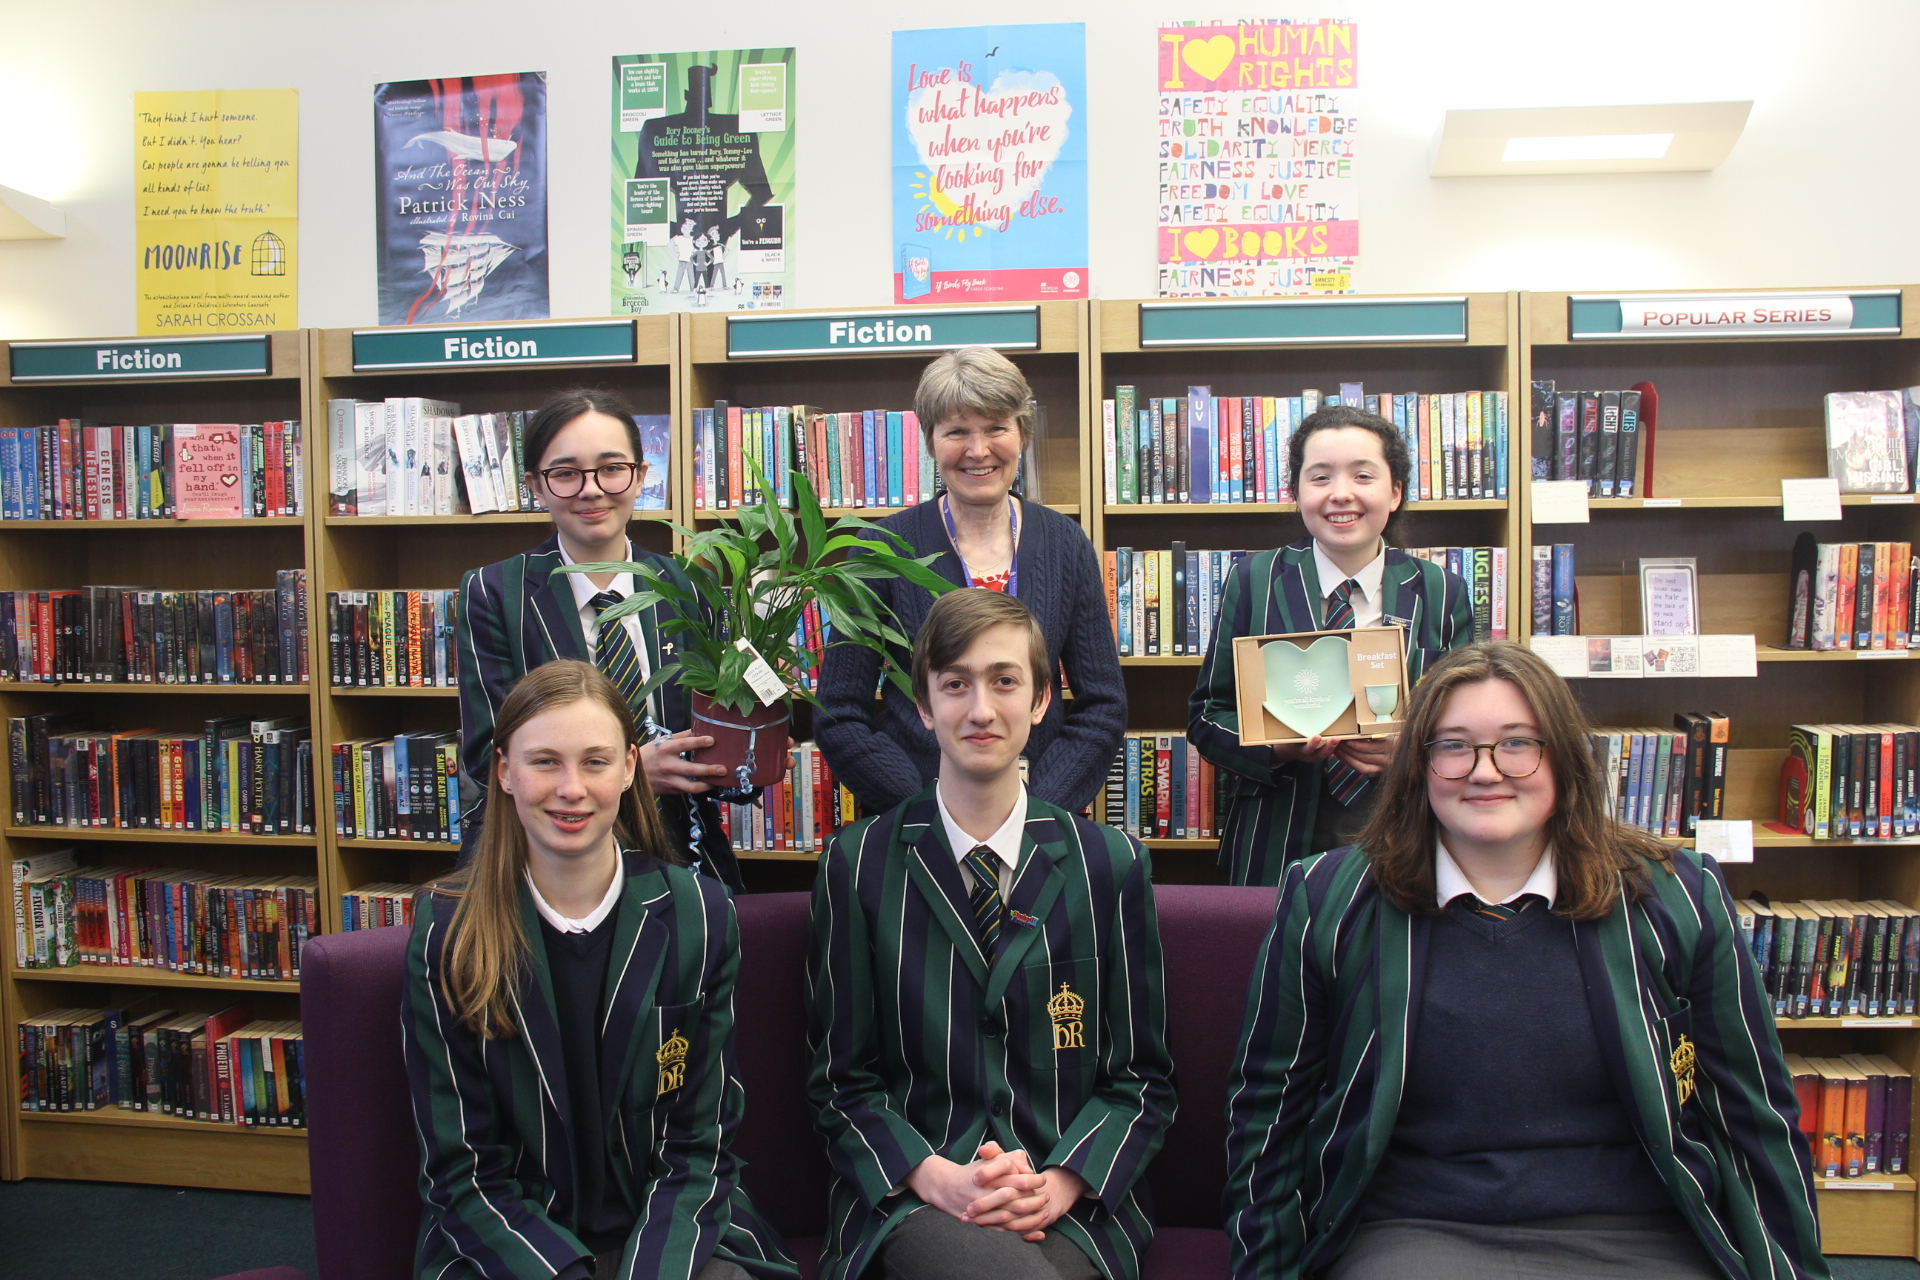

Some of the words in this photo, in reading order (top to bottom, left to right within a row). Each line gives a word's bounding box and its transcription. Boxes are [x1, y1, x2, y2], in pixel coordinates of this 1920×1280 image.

[1161, 33, 1184, 88] I
[1239, 26, 1351, 57] HUMAN
[908, 62, 950, 91] Love
[957, 59, 972, 83] is
[1239, 58, 1352, 89] RIGHTS
[918, 88, 970, 123] what
[974, 84, 1059, 118] happens
[1159, 98, 1228, 117] SAFETY
[1242, 94, 1339, 114] EQUALITY
[165, 112, 187, 122] think
[191, 113, 197, 122] I
[200, 111, 218, 122] hurt
[221, 114, 257, 122] someone.
[1159, 119, 1223, 137] TRUTH
[1238, 116, 1358, 137] KNOWLEDGE
[654, 135, 678, 146] Guide
[682, 135, 692, 145] to
[696, 135, 720, 147] Being
[724, 134, 750, 143] Green
[666, 127, 681, 135] Rory
[683, 126, 710, 135] Rooney's
[928, 124, 981, 157] when
[988, 121, 1051, 162] you're
[143, 137, 157, 146] But
[159, 137, 165, 146] I
[200, 136, 215, 149] You
[219, 135, 242, 145] hear?
[1159, 138, 1279, 160] SOLIDARITY
[1292, 138, 1354, 158] MERCY
[143, 160, 155, 170] Cos
[158, 160, 183, 173] people
[202, 162, 228, 174] gonna
[232, 157, 239, 167] be
[243, 157, 270, 173] telling
[274, 160, 289, 170] you
[394, 165, 426, 180] And
[429, 163, 450, 178] The
[453, 164, 489, 176] Ocean
[936, 161, 1004, 194] looking
[1013, 151, 1044, 186] for
[1159, 160, 1255, 182] FAIRNESS
[1269, 159, 1351, 179] JUSTICE
[143, 183, 155, 193] all
[158, 183, 180, 193] kinds
[184, 181, 194, 195] of
[196, 183, 211, 192] lies.
[446, 178, 470, 191] Was
[474, 176, 496, 189] Our
[500, 172, 529, 195] Sky
[1159, 182, 1249, 204] FREEDOM
[1261, 182, 1308, 200] LOVE
[143, 207, 149, 216] I
[152, 206, 170, 215] need
[173, 208, 187, 219] you
[190, 206, 198, 214] to
[201, 205, 222, 214] know
[225, 204, 237, 213] the
[399, 193, 468, 214] Patrick
[479, 191, 525, 209] Ness
[915, 192, 1011, 233] something
[1020, 189, 1064, 218] else.
[1159, 203, 1228, 224] SAFETY
[1242, 203, 1339, 223] EQUALITY
[410, 215, 446, 225] illustrated
[449, 214, 456, 226] by
[462, 212, 494, 221] Rovina
[499, 210, 515, 220] Cai
[1167, 229, 1182, 261] I
[1222, 225, 1328, 258] BOOKS
[144, 241, 242, 270] MOONRISE
[935, 281, 941, 293] If
[944, 281, 960, 290] Birds
[961, 279, 972, 291] Fly
[972, 278, 986, 286] Back
[1159, 267, 1255, 289] FAIRNESS
[157, 313, 201, 327] SARAH
[207, 313, 275, 326] CROSSAN
[1643, 311, 1746, 326] POPULAR
[1753, 308, 1832, 324] SERIES
[829, 320, 931, 344] Fiction
[444, 336, 536, 359] Fiction
[96, 348, 182, 370] Fiction
[423, 406, 454, 416] SHADOWS
[1195, 401, 1203, 410] U
[1346, 398, 1357, 407] W
[1195, 412, 1203, 422] V
[1605, 406, 1618, 433] LIGHT
[86, 451, 97, 504] NEMESIS
[101, 451, 111, 504] GENESIS
[179, 464, 204, 472] fell
[1847, 471, 1904, 483] MISSING
[1475, 551, 1488, 604] UGLIES
[1357, 652, 1397, 661] Breakfast
[436, 754, 444, 773] SAINT
[1129, 741, 1137, 781] SPECIALS
[1141, 741, 1154, 796] EXTRAS
[162, 756, 171, 801] GEEKHOOD
[174, 756, 182, 801] GEEKHOOD
[438, 777, 446, 797] DEATH
[1158, 758, 1169, 811] SWARM
[15, 885, 24, 929] JUNGLE
[33, 896, 43, 929] EXPLORER
[111, 1020, 116, 1028] S
[218, 1044, 228, 1079] PHOENIX
